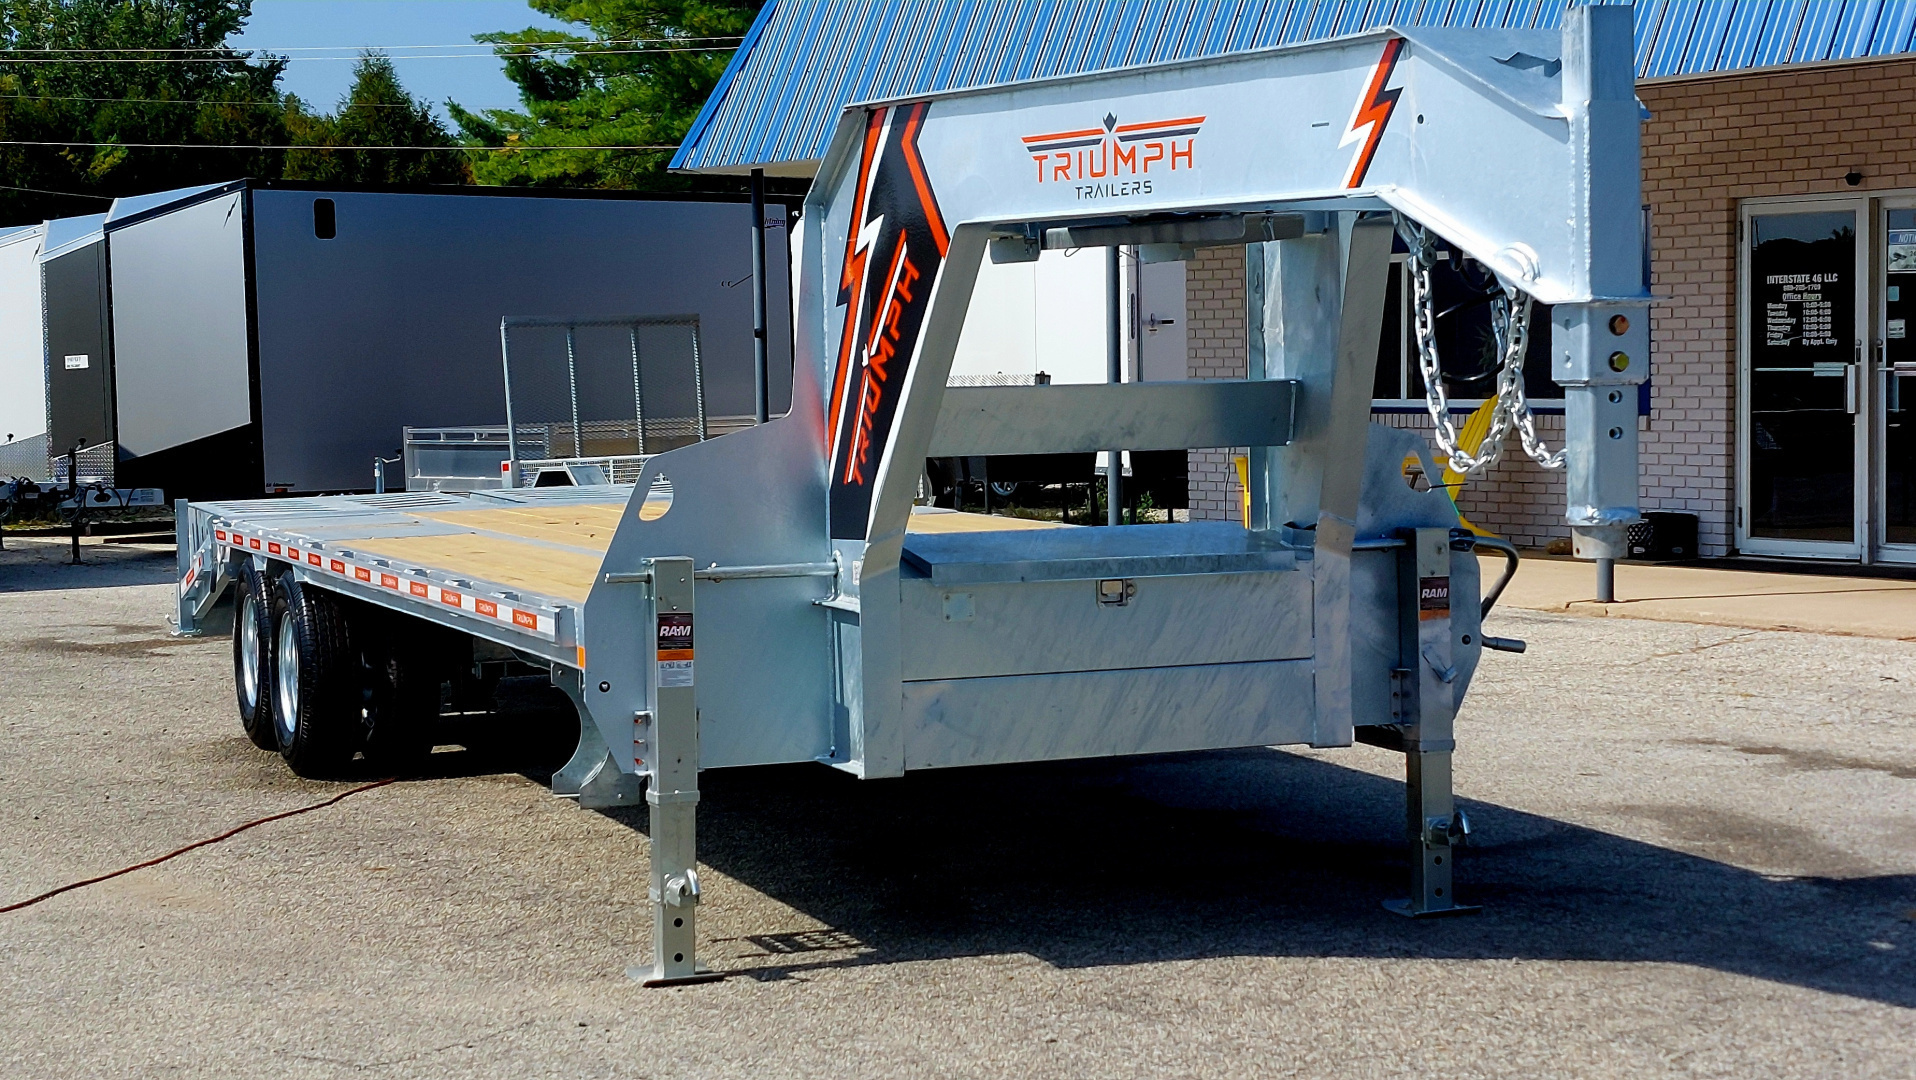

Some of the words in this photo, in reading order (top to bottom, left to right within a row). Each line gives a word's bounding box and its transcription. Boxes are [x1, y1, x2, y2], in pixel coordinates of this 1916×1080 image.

[1032, 137, 1194, 183] TRIUMPH
[1075, 180, 1153, 200] TRAILERS
[1767, 275, 1810, 284] INTERSTATE
[1812, 273, 1822, 283] 46
[1824, 272, 1838, 282] LLC
[1782, 292, 1801, 301] Office
[1802, 292, 1822, 300] Hours
[1766, 302, 1788, 310] Monday
[1766, 317, 1797, 325] Wednesday
[1766, 324, 1791, 332] Thursday
[1766, 331, 1784, 339] Friday
[1766, 339, 1790, 347] Saturday
[852, 256, 920, 486] TRIUMPH
[1421, 588, 1448, 599] RAM
[659, 625, 692, 637] RAM
